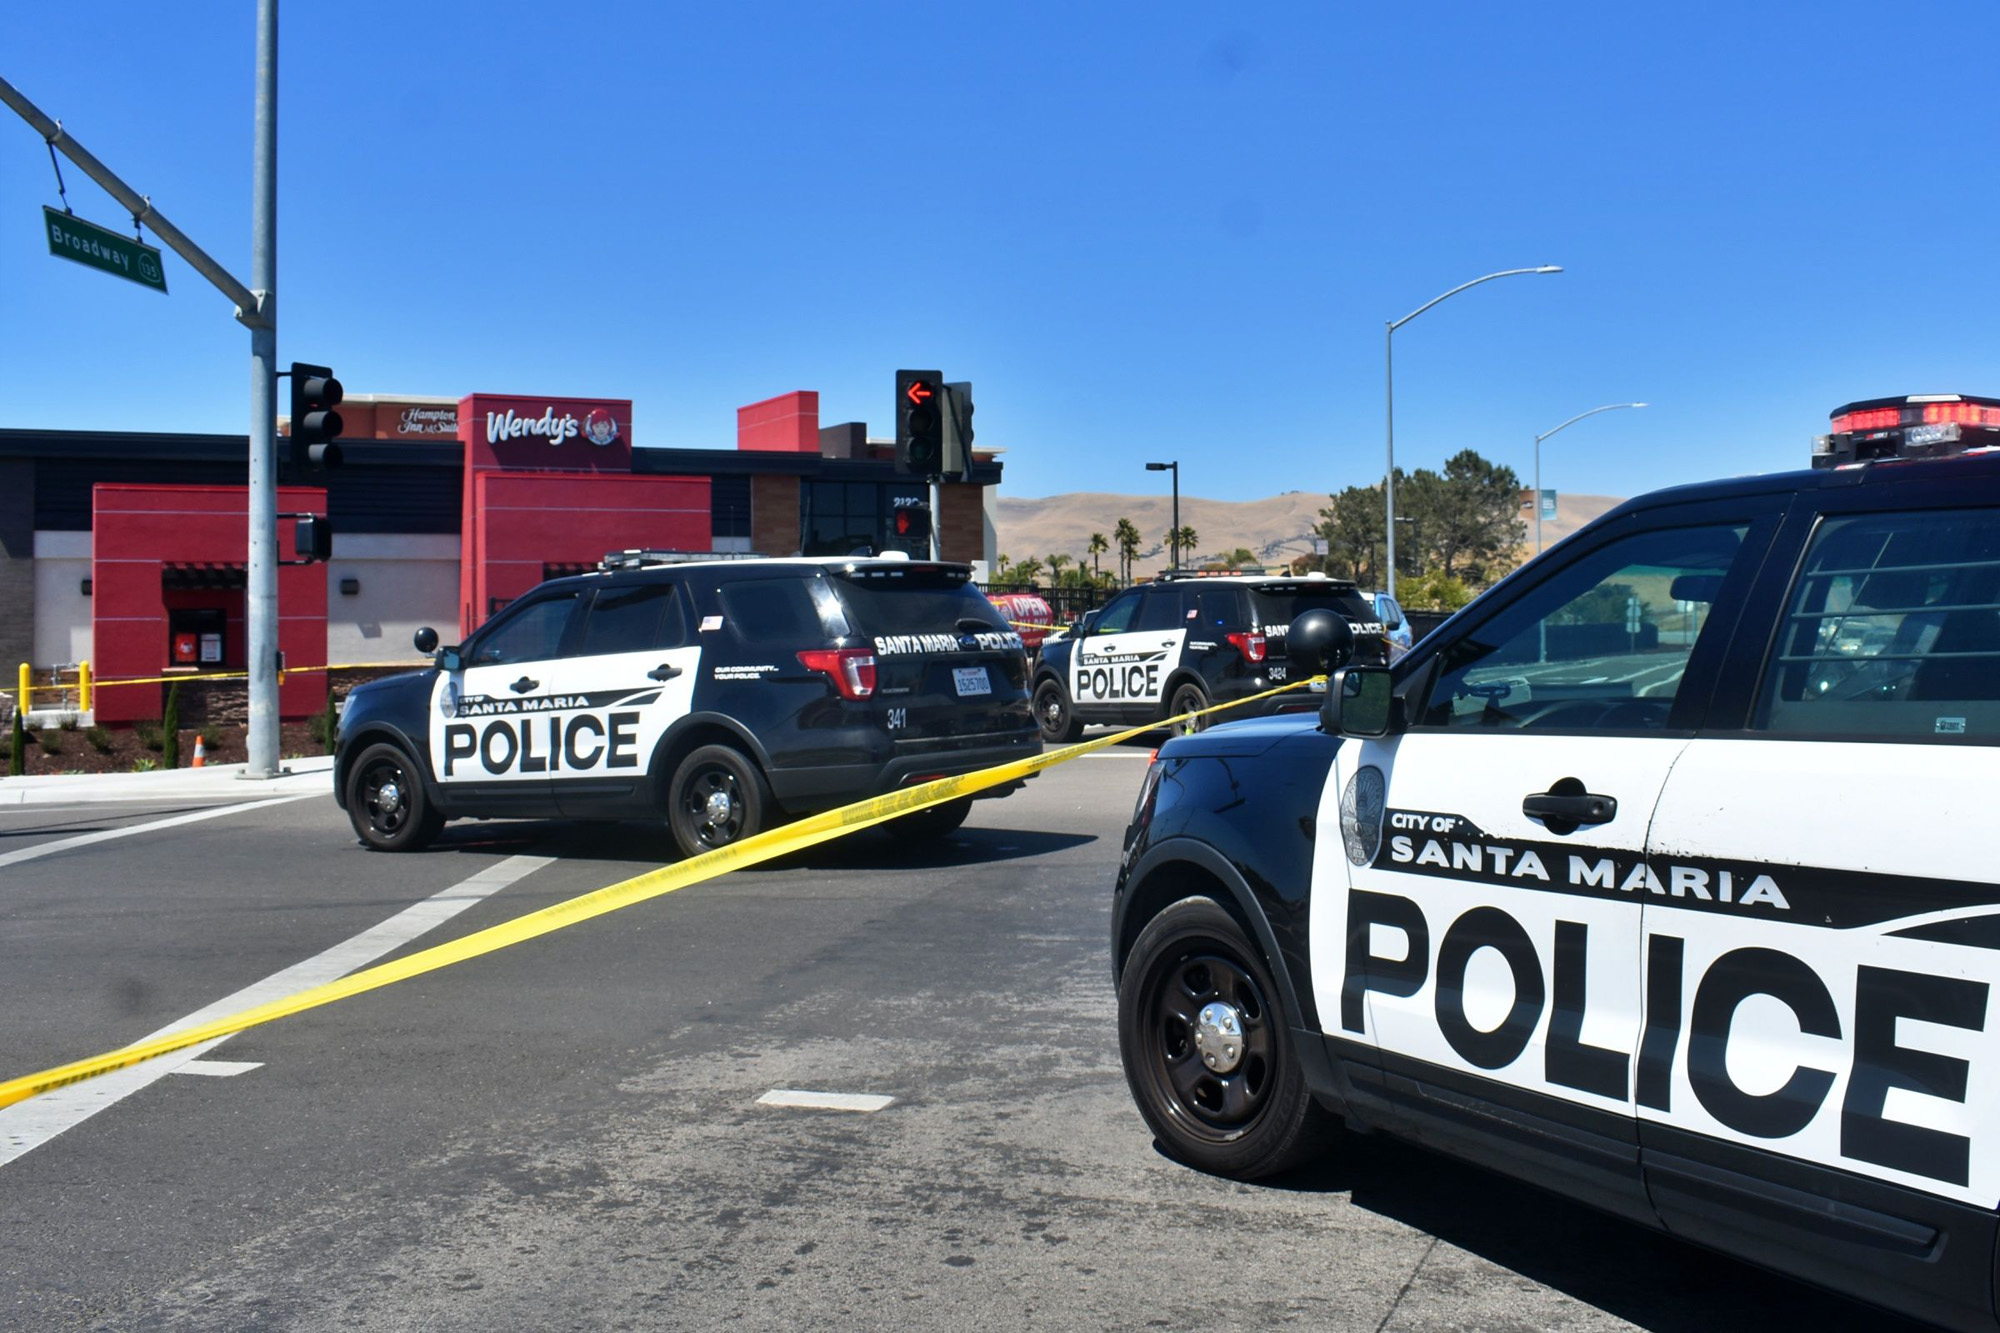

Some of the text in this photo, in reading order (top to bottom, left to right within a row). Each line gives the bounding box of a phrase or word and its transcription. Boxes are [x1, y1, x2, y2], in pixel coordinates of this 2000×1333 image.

[51, 224, 128, 271] Broadway
[401, 408, 456, 421] Hampton
[486, 406, 578, 445] Wendy's
[1013, 597, 1047, 616] OPEN
[874, 634, 960, 655] SANTA MARIA
[975, 632, 1023, 650] POLICE
[1083, 656, 1109, 665] SANTA
[1111, 654, 1140, 663] MARIA
[1077, 664, 1158, 700] POLICE
[1268, 667, 1286, 679] 3424
[460, 696, 589, 715] SANTA MARIA
[887, 708, 906, 729] 341
[444, 711, 640, 776] POLICE
[1391, 813, 1456, 833] CITY OF
[1391, 835, 1790, 909] SANTA MARIA
[1341, 887, 1990, 1188] POLICE
